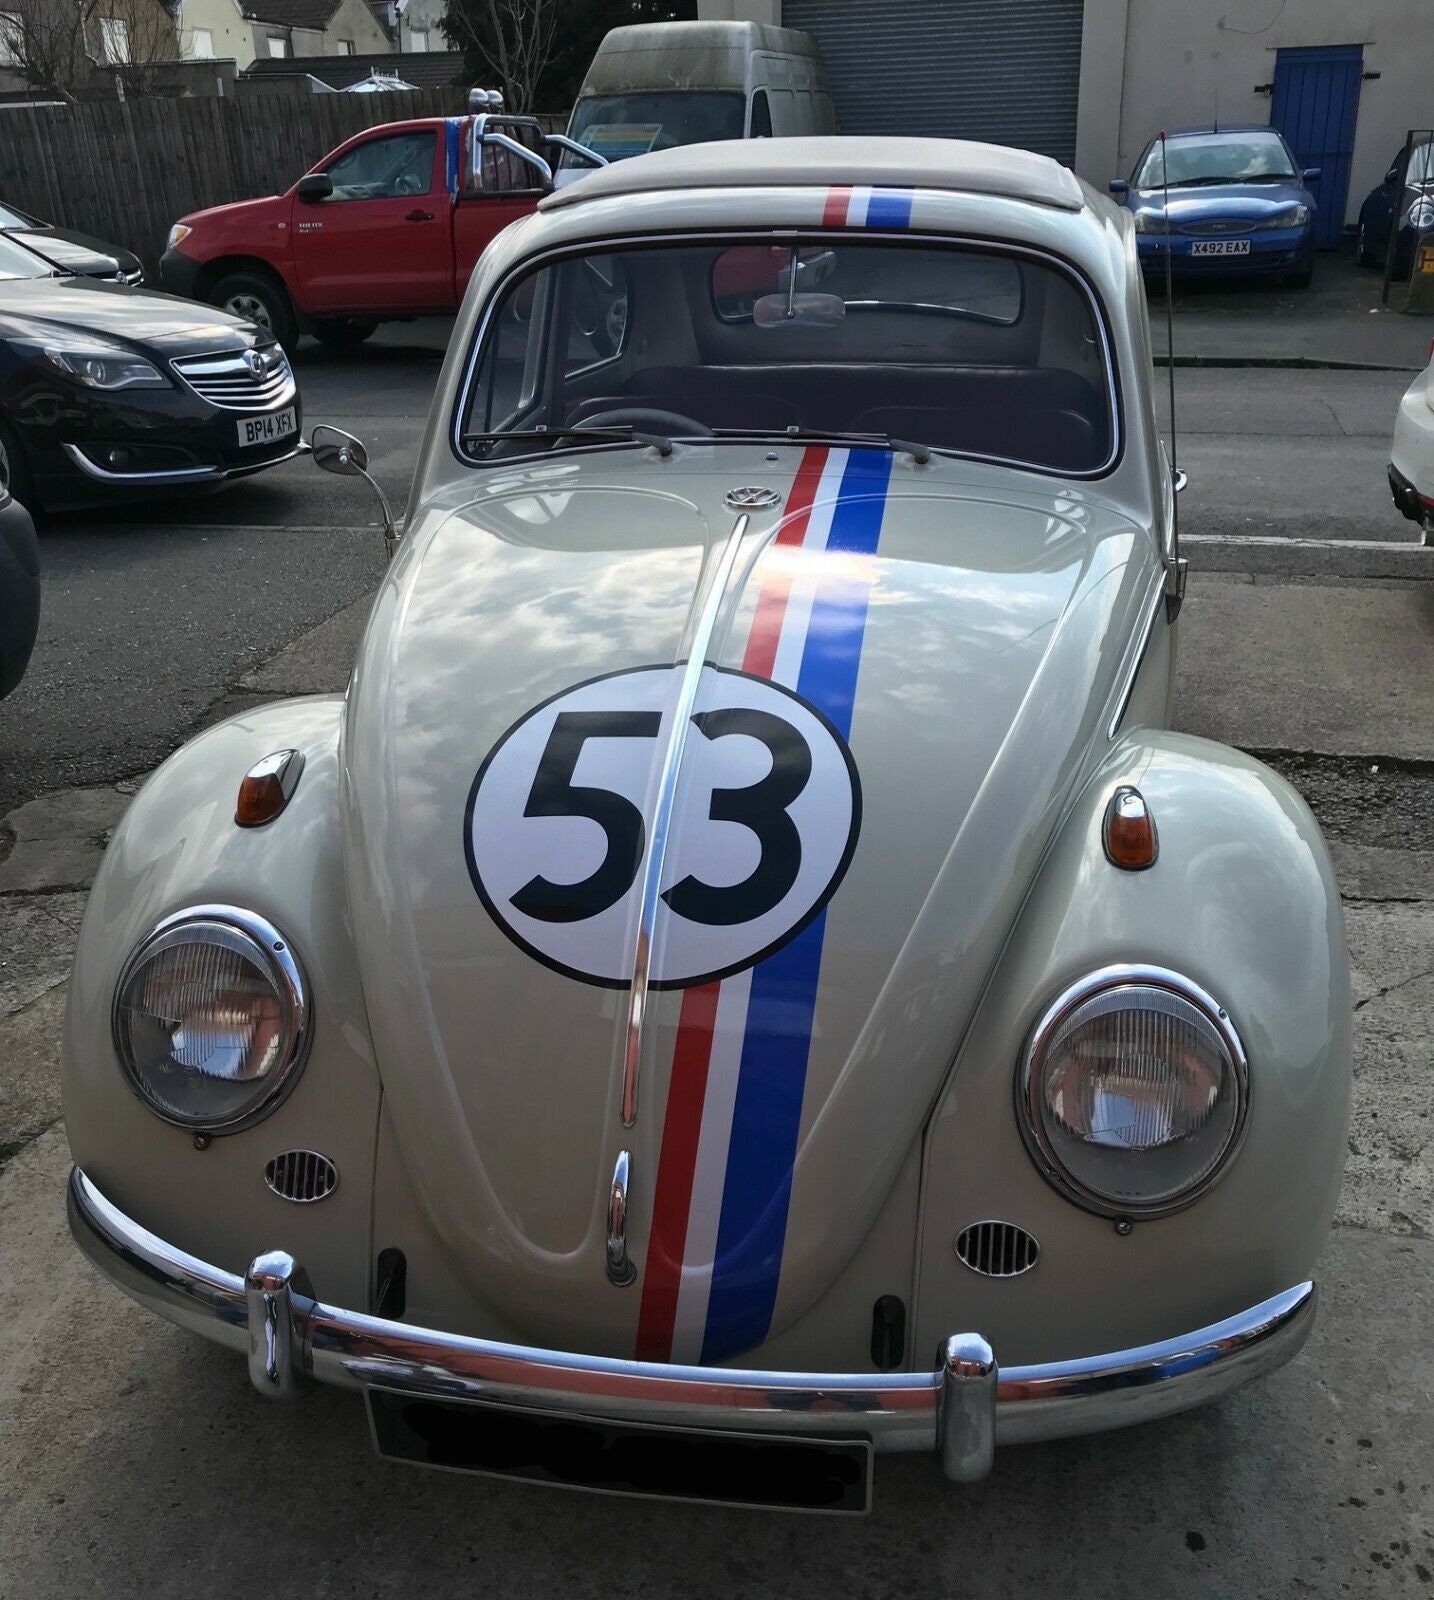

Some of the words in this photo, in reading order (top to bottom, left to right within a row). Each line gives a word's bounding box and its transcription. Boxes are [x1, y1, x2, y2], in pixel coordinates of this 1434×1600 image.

[1194, 243, 1223, 254] X492
[1226, 241, 1248, 253] EAX
[245, 418, 274, 442] BP14
[275, 411, 293, 435] XFX
[509, 707, 812, 926] 53
